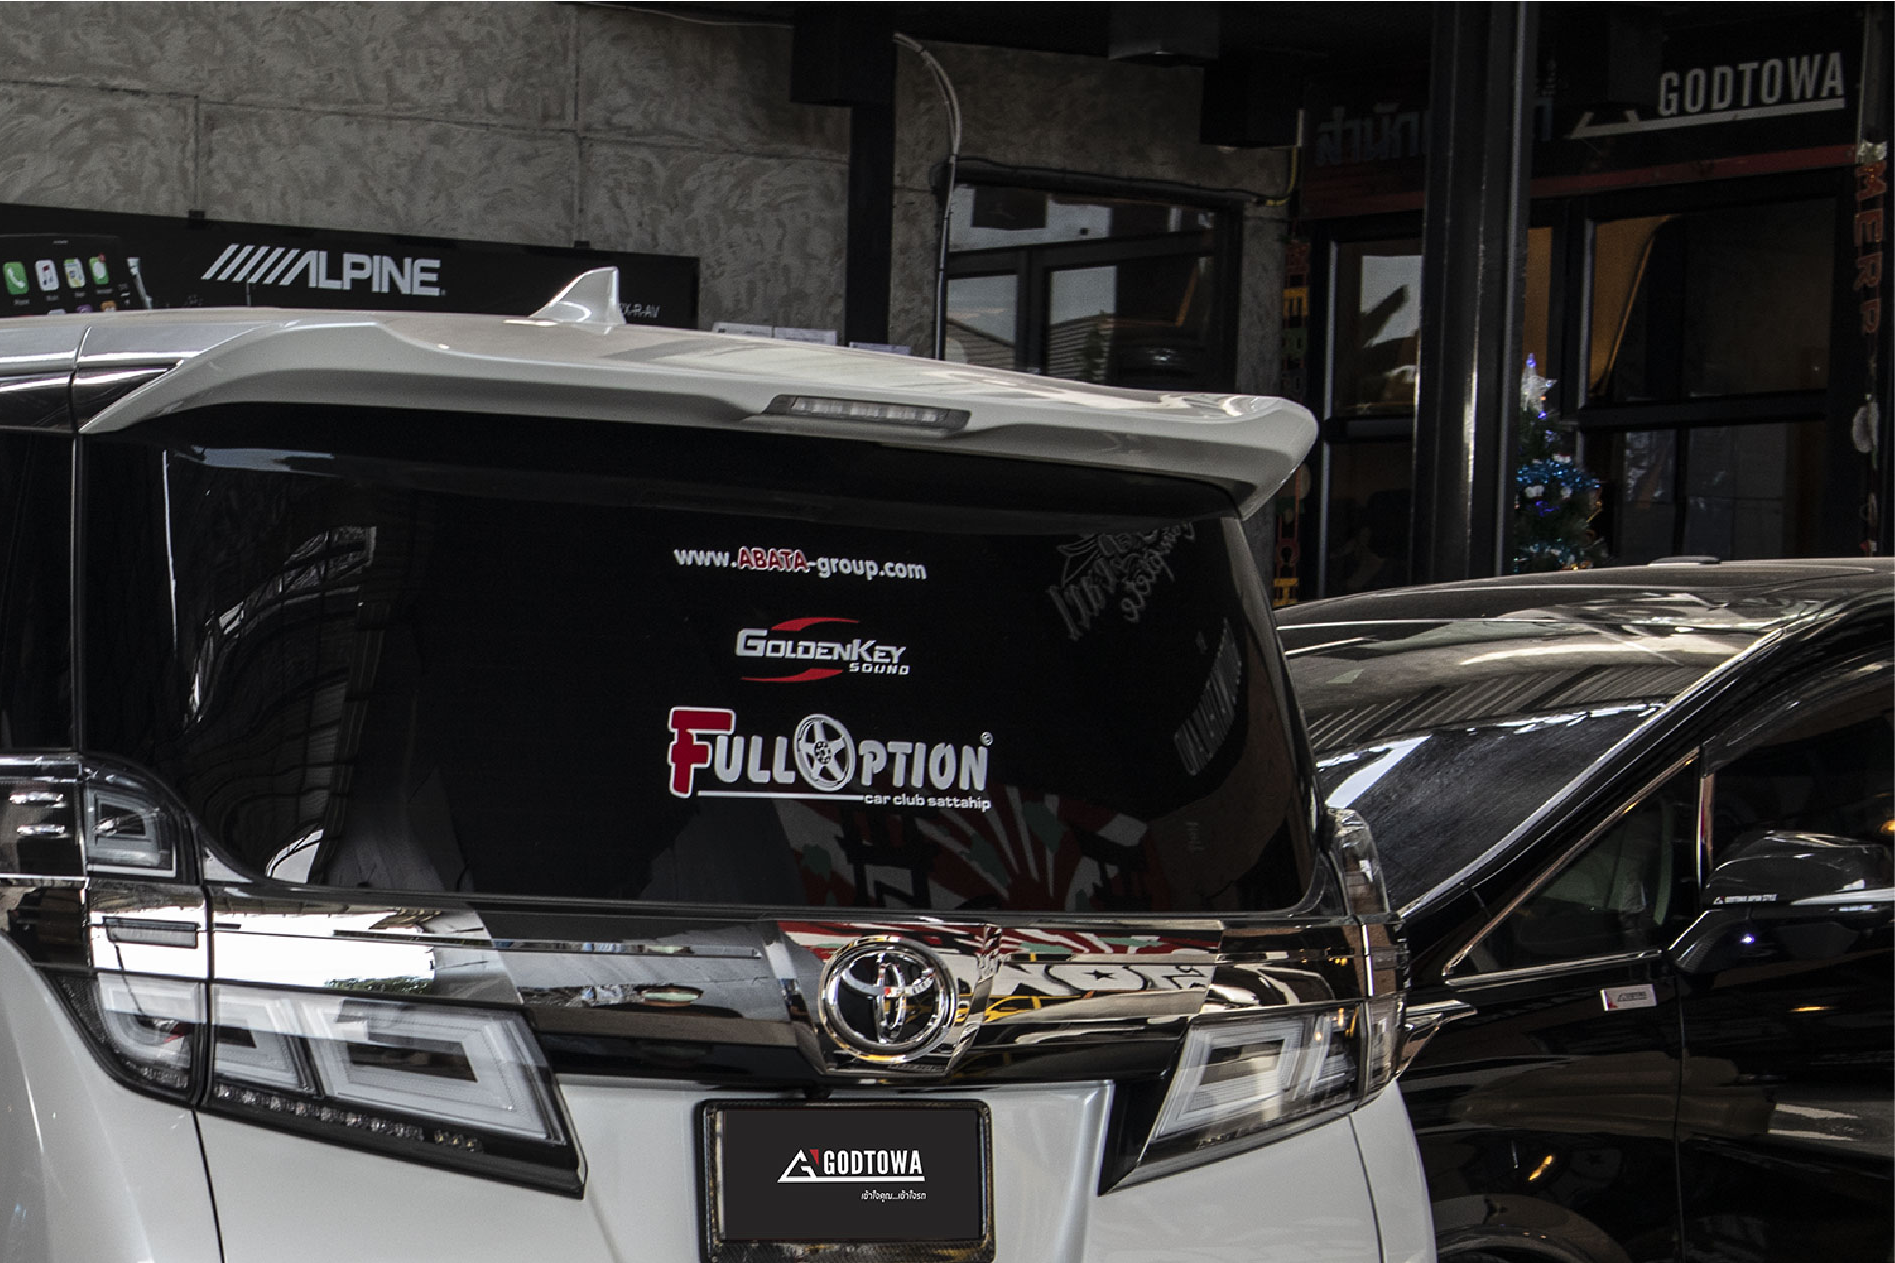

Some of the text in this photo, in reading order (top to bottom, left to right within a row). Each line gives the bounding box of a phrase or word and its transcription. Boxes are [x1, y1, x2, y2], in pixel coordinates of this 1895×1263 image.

[1659, 52, 1844, 117] GODTOWA
[278, 248, 442, 297] ALPINE
[673, 545, 927, 581] www.ABATA-group.com
[848, 661, 910, 675] SOUND
[863, 793, 992, 813] car club sattahip
